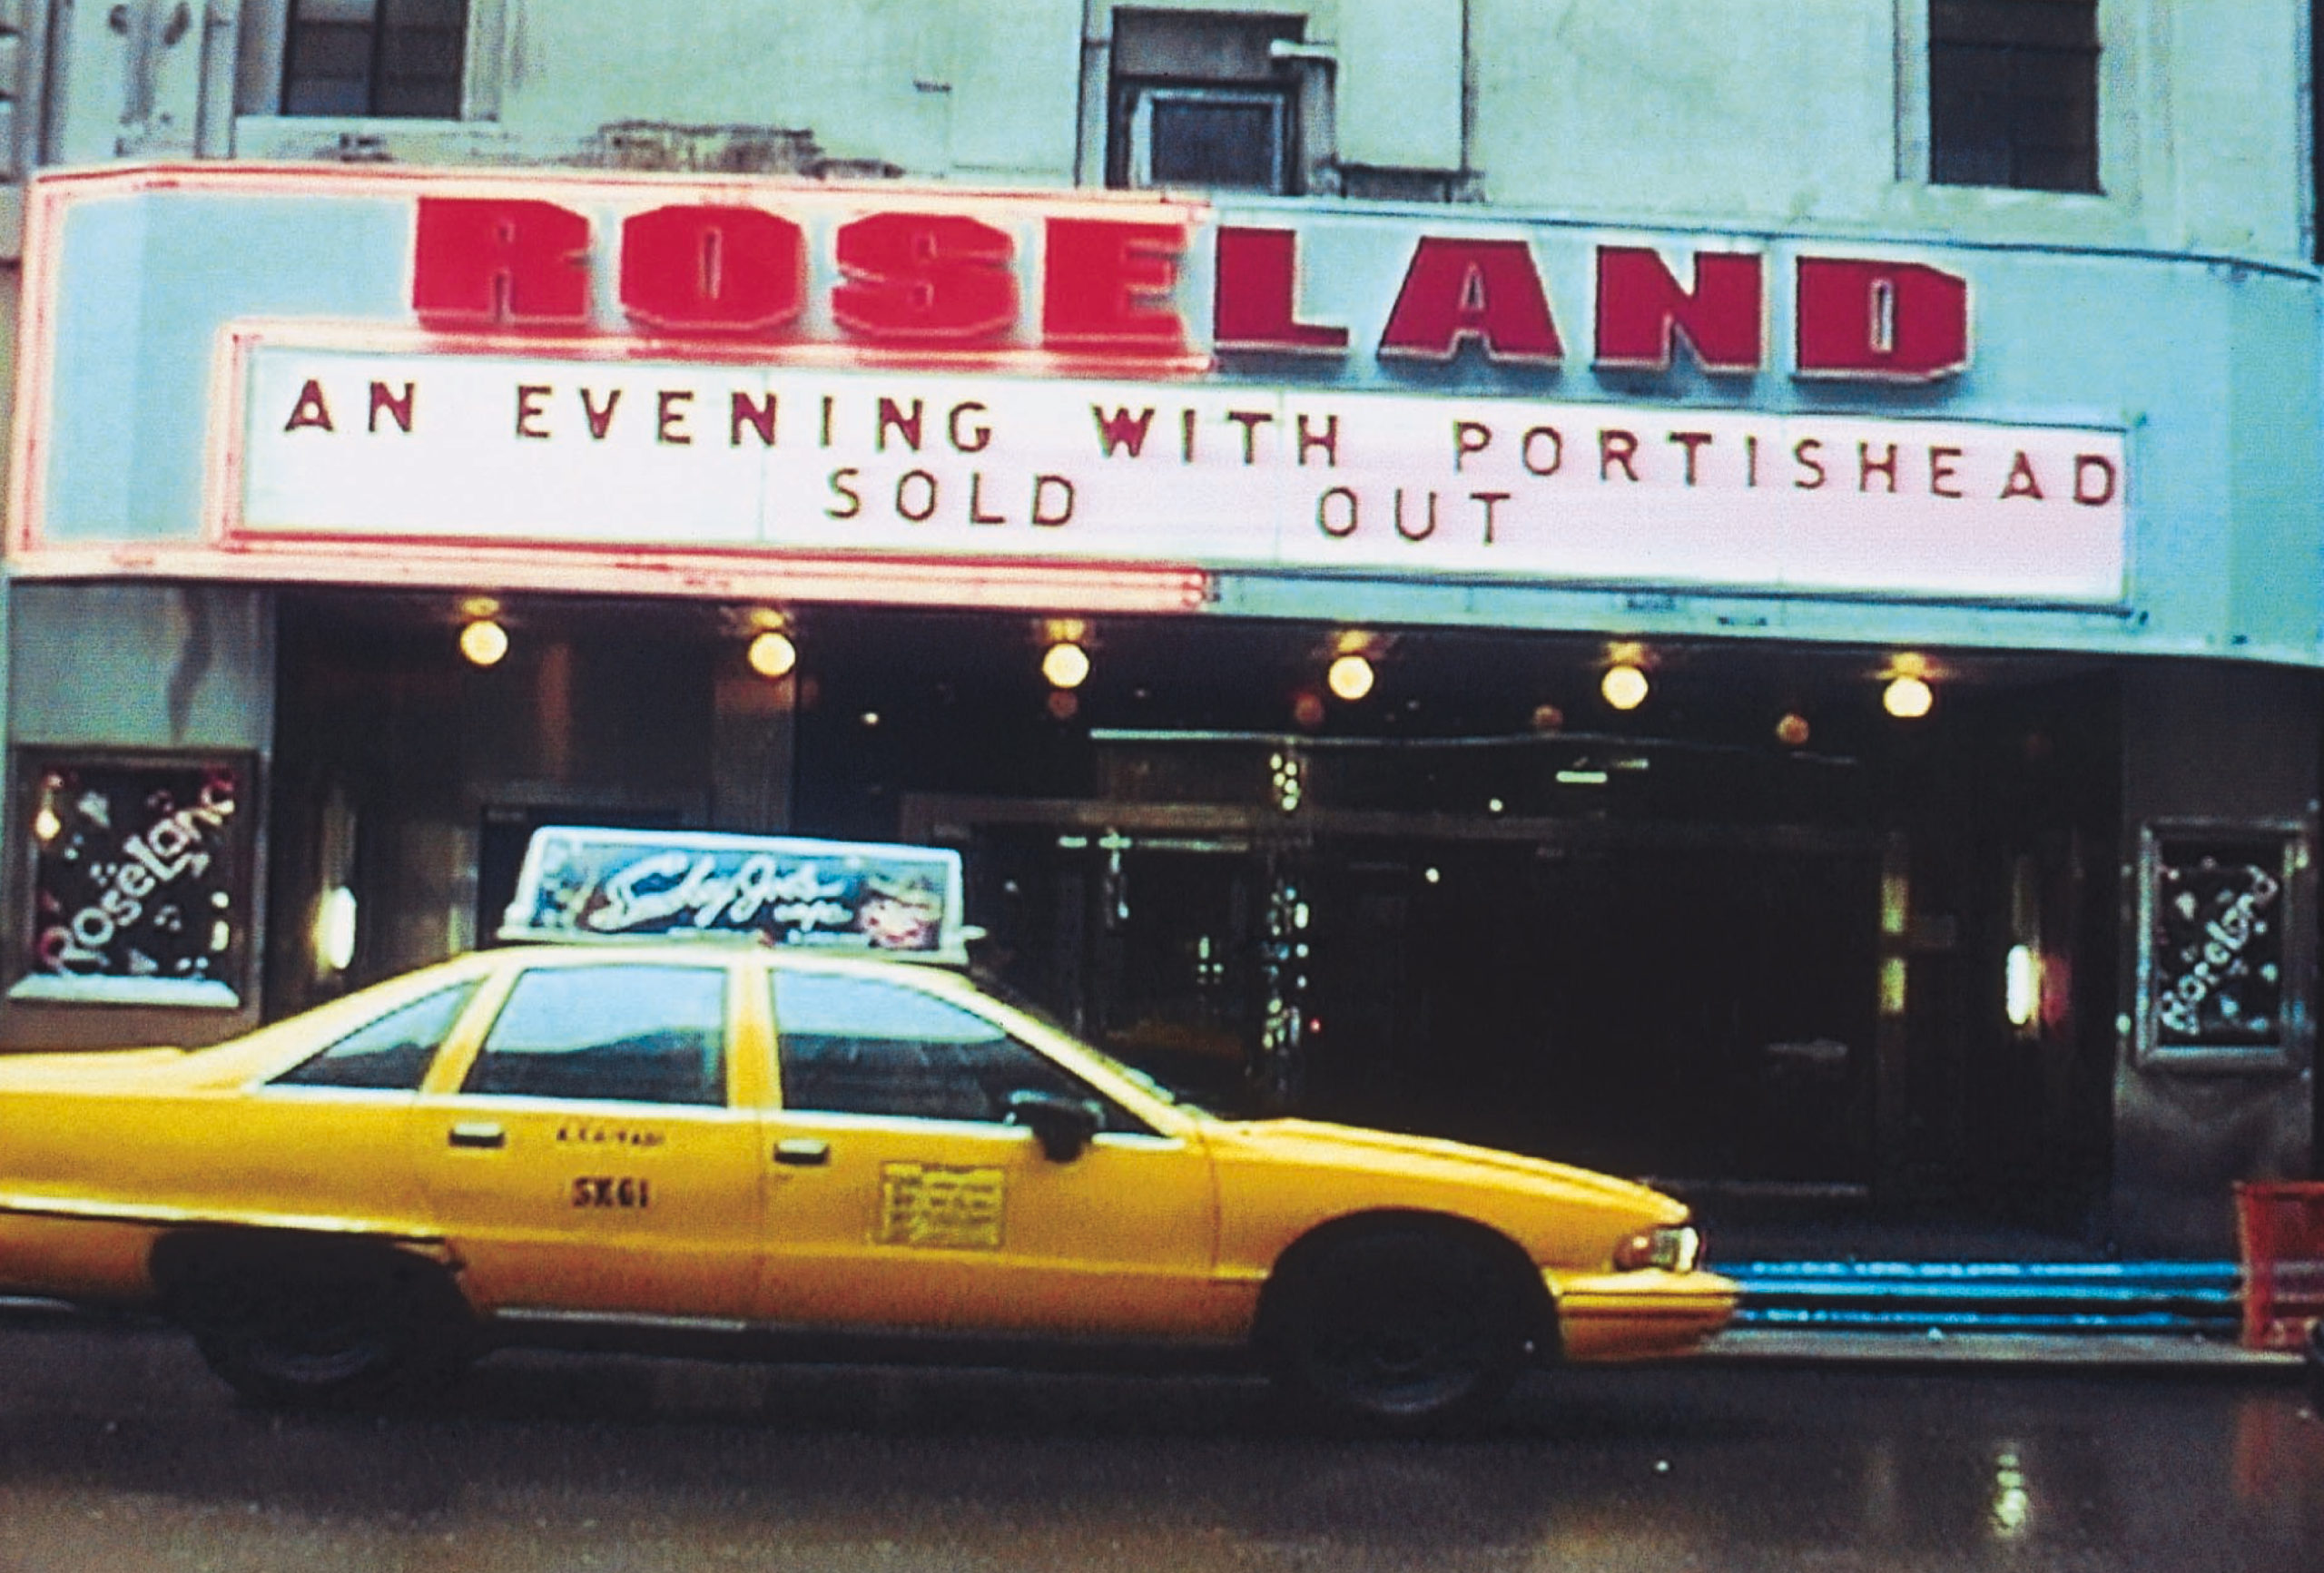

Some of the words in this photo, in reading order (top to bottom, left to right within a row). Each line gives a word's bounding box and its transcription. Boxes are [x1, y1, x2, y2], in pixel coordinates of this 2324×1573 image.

[411, 197, 1970, 384] ROSELAND
[285, 380, 415, 433] AN
[516, 385, 991, 453] EVENING
[1093, 406, 1338, 468] WITH
[1454, 421, 2117, 506] PORTISHEAD
[830, 467, 1075, 527] SOLD
[1319, 486, 1512, 545] OUT
